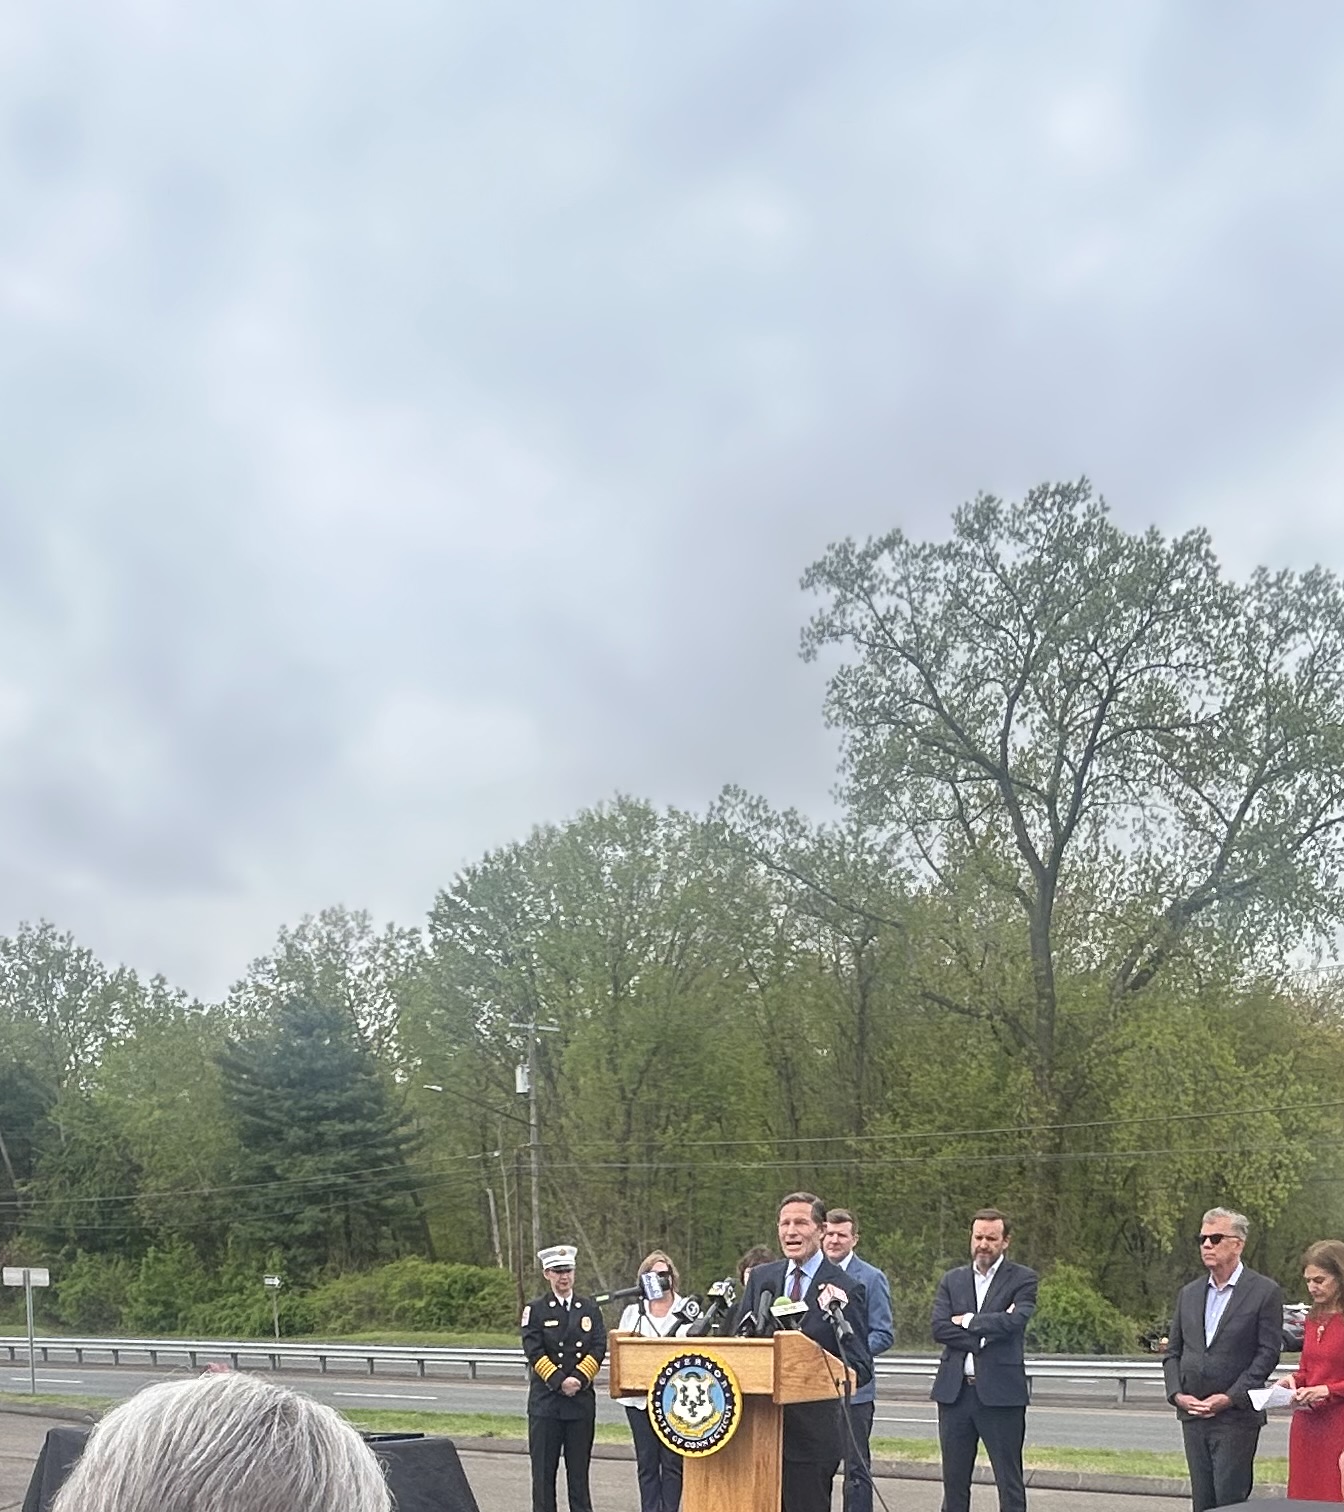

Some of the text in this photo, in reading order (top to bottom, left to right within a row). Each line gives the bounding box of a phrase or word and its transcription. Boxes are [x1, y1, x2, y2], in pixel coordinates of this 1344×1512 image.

[659, 1358, 729, 1389] GOVERNOR
[655, 1401, 733, 1449] STATE OF CONNECTICUT
